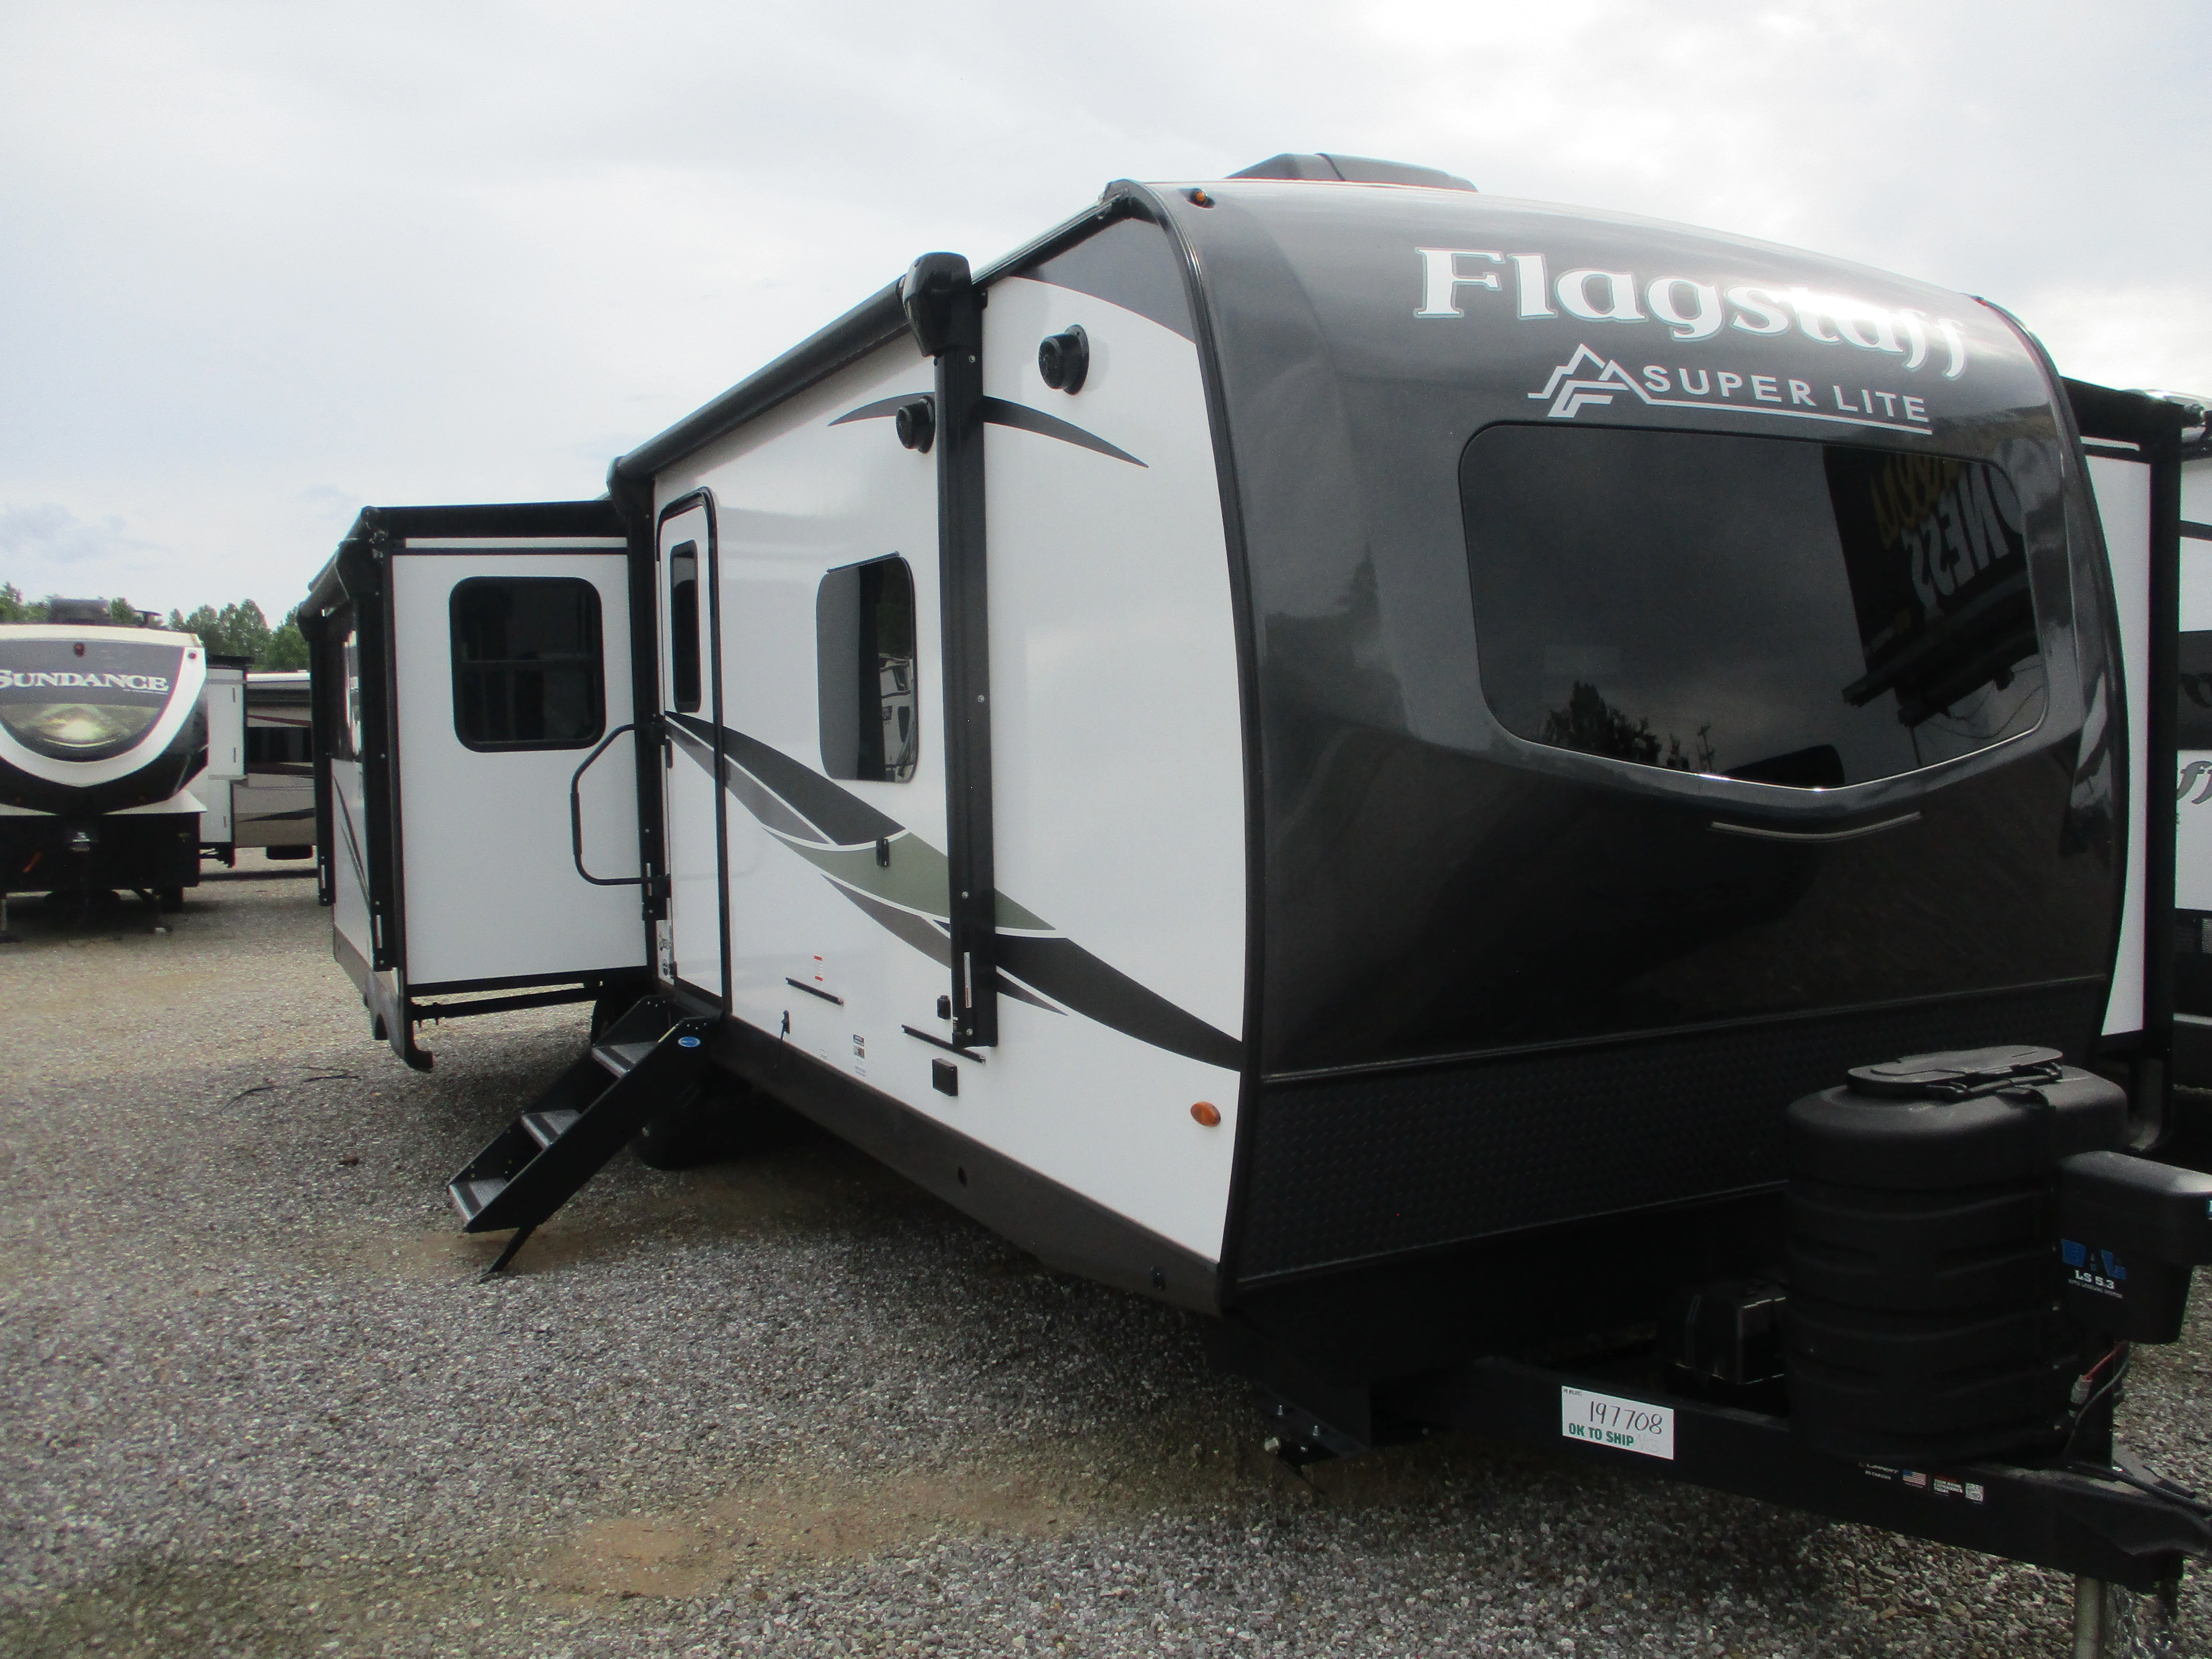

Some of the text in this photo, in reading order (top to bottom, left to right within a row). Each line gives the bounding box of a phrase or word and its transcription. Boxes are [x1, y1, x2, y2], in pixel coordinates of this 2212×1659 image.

[1414, 246, 1968, 381] Flagstaff
[1642, 365, 1929, 423] SUPER LITE
[2075, 1269, 2092, 1283] LS
[1590, 1401, 1662, 1434] 197708
[1568, 1422, 1635, 1447] OK TO SHIP
